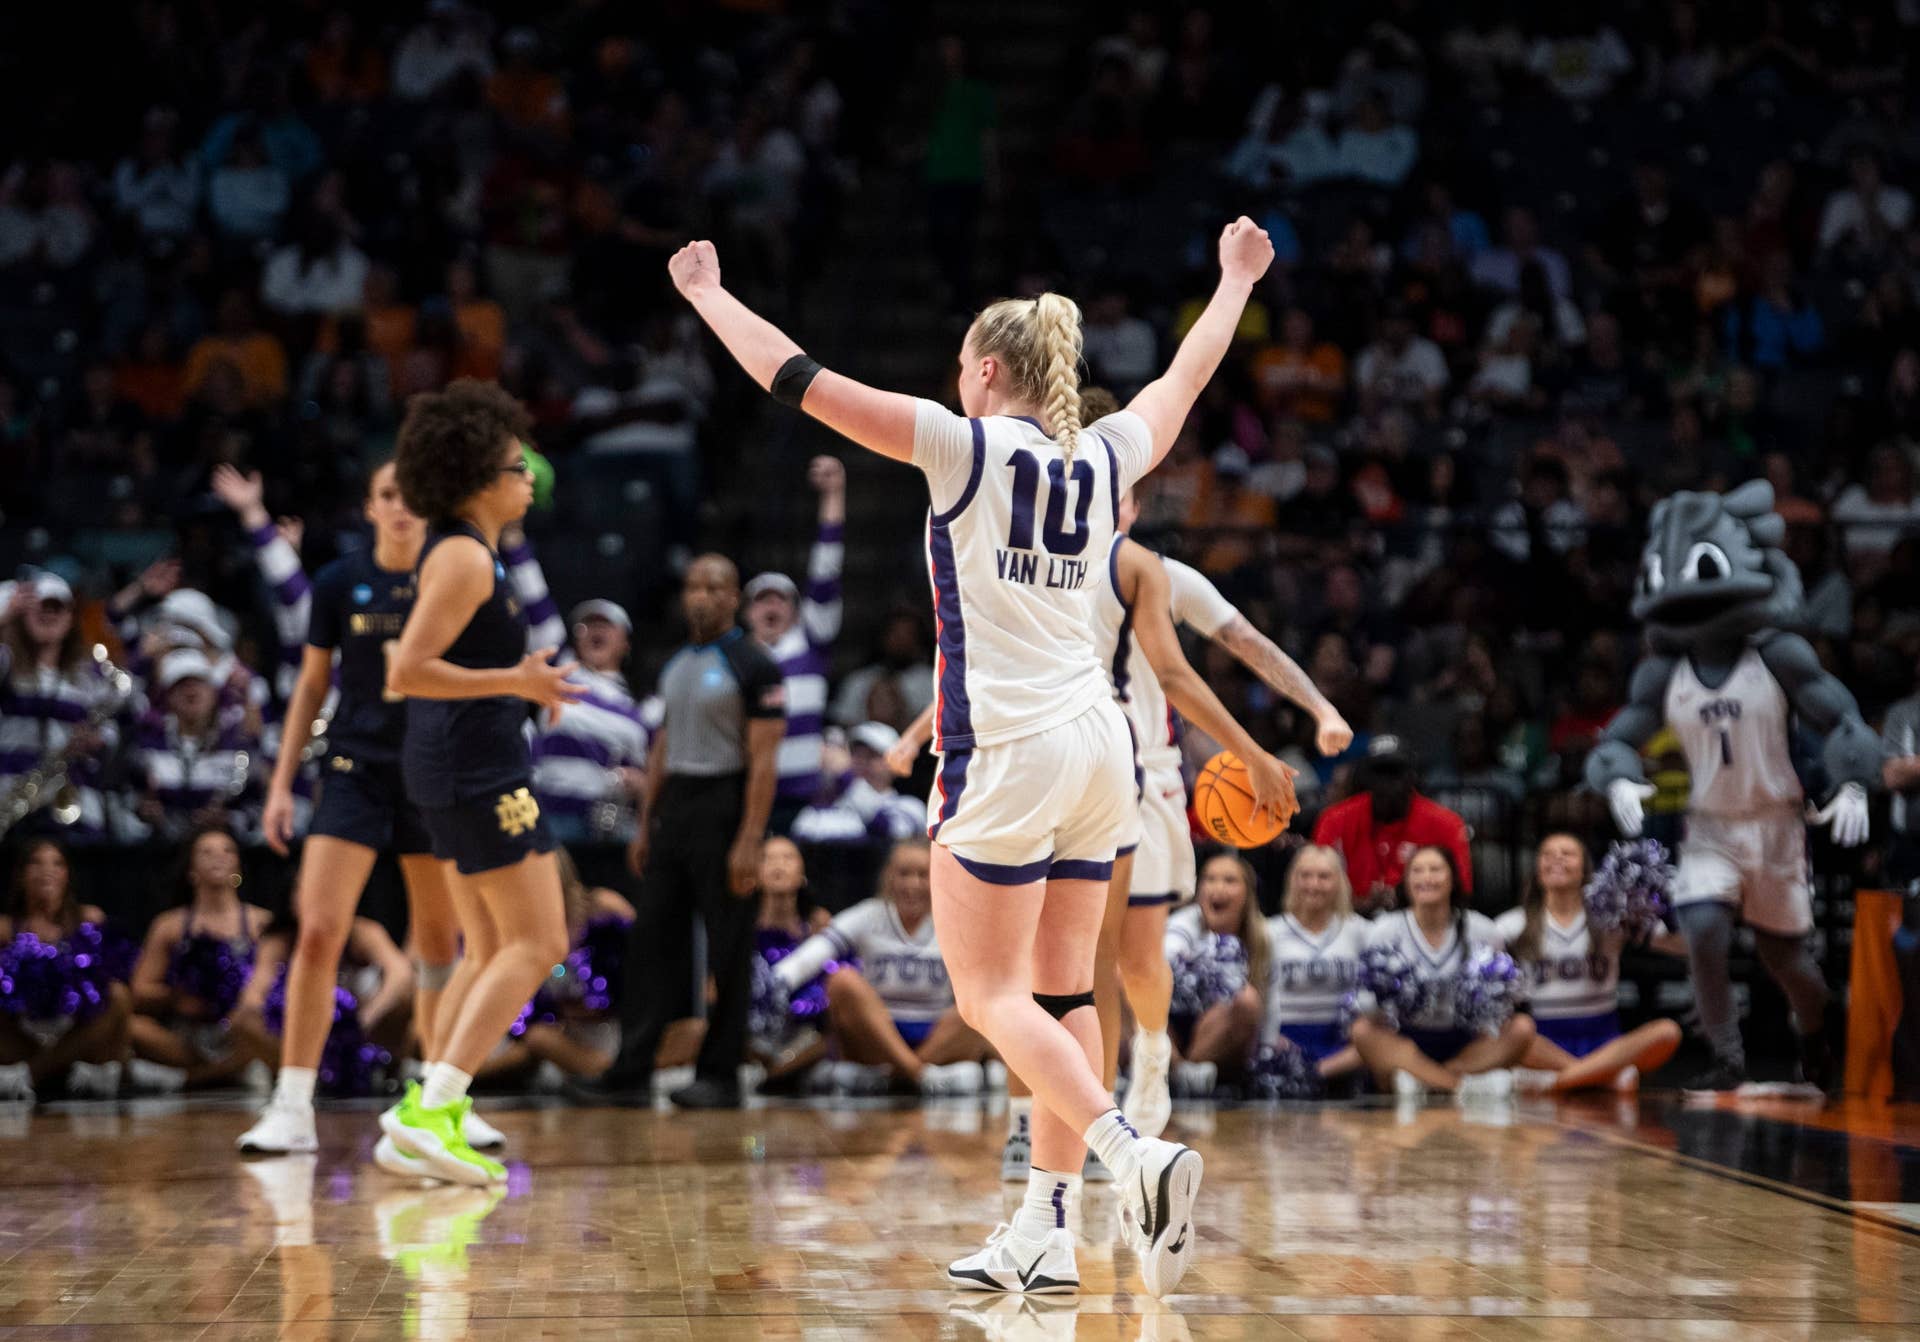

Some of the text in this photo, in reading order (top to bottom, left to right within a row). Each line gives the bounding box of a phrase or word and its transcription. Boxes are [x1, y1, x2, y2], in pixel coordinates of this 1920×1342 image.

[1006, 448, 1095, 556] 10
[996, 549, 1088, 590] VAN LITH
